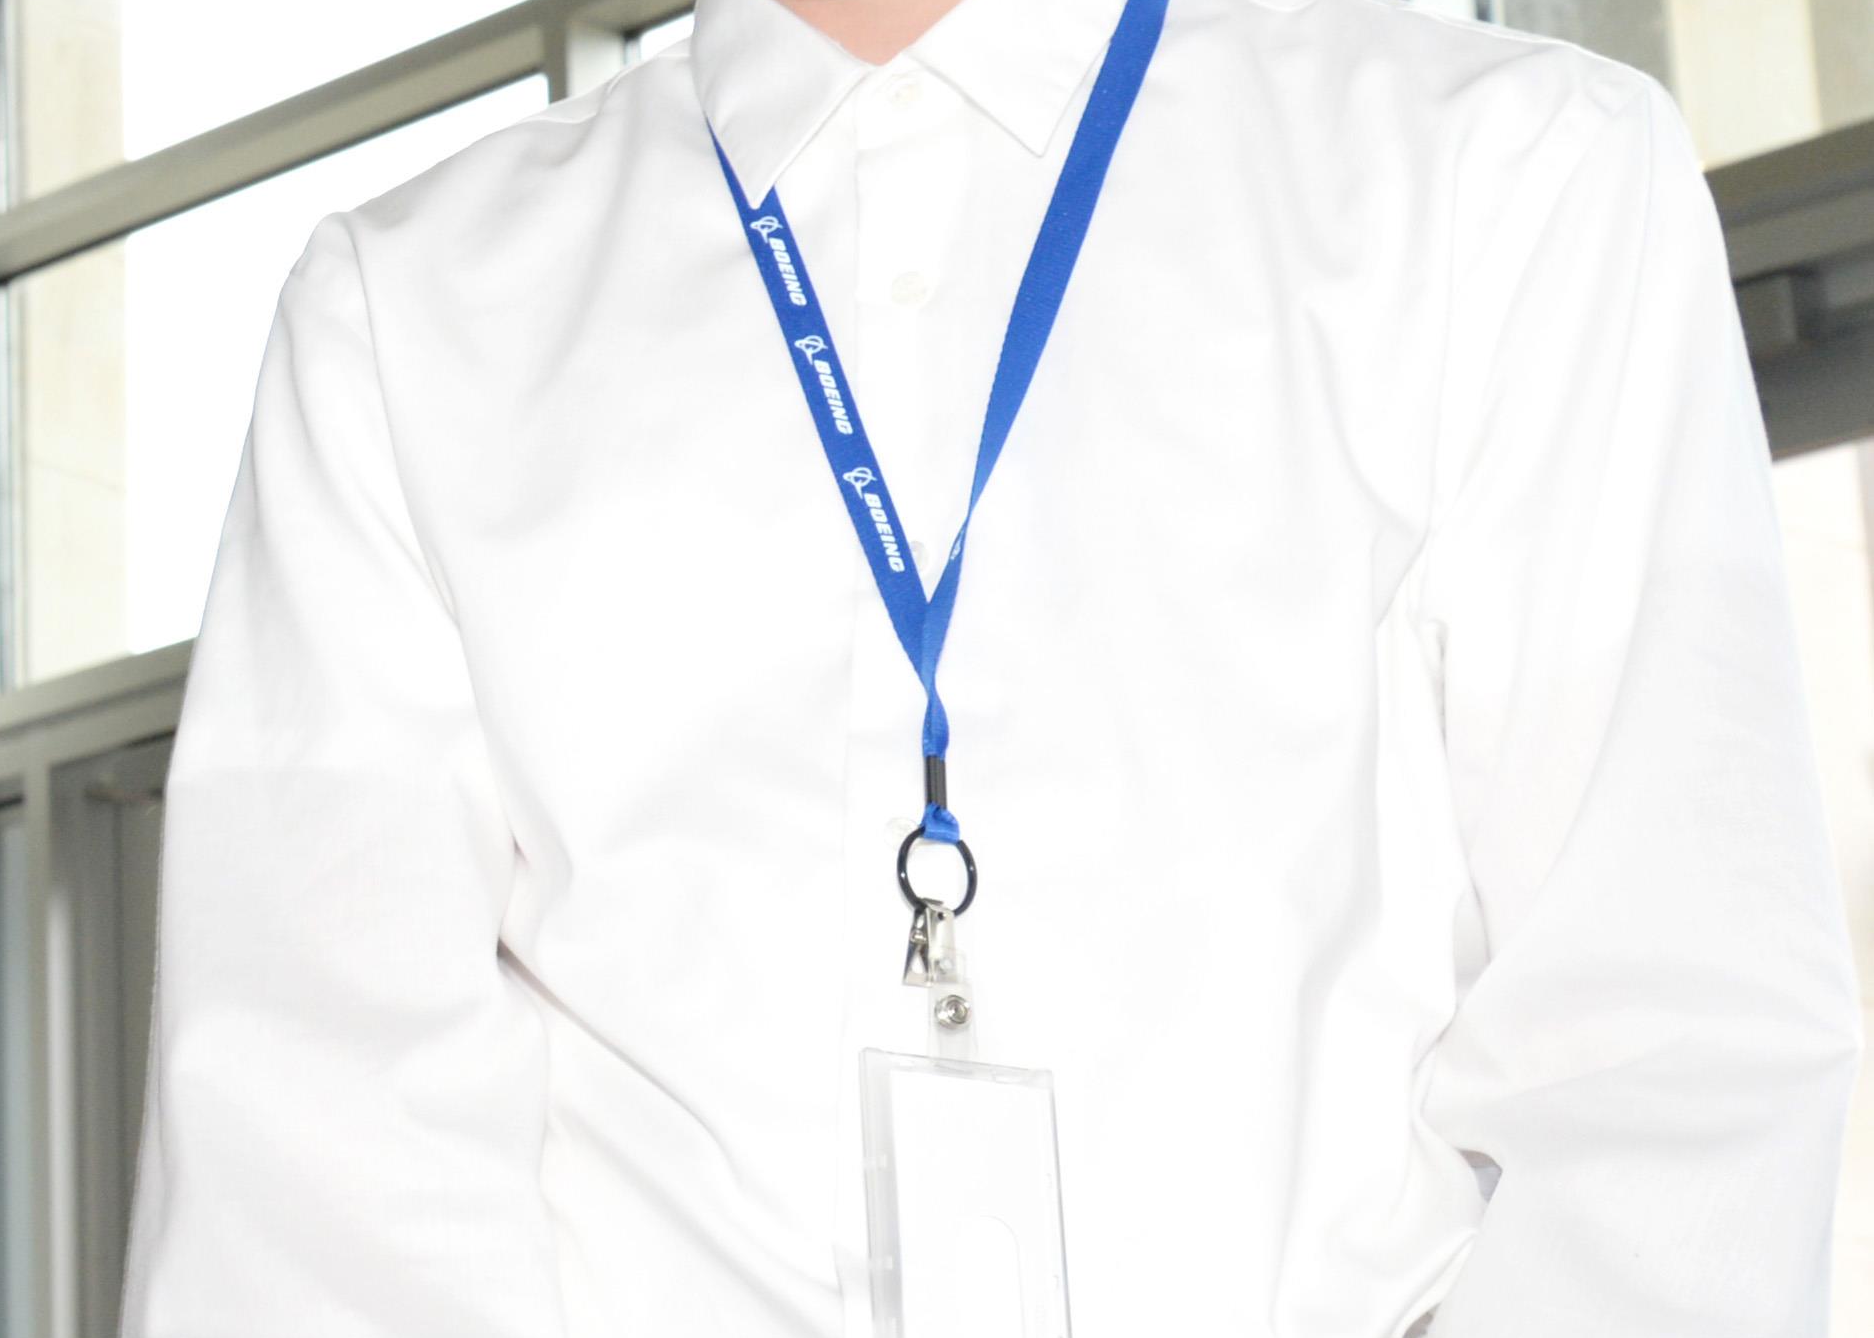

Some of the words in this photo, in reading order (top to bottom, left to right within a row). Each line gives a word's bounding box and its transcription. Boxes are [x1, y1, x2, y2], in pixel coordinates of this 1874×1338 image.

[767, 236, 807, 307] BOEING
[812, 358, 854, 436] BOEING
[861, 491, 905, 573] BOEING
